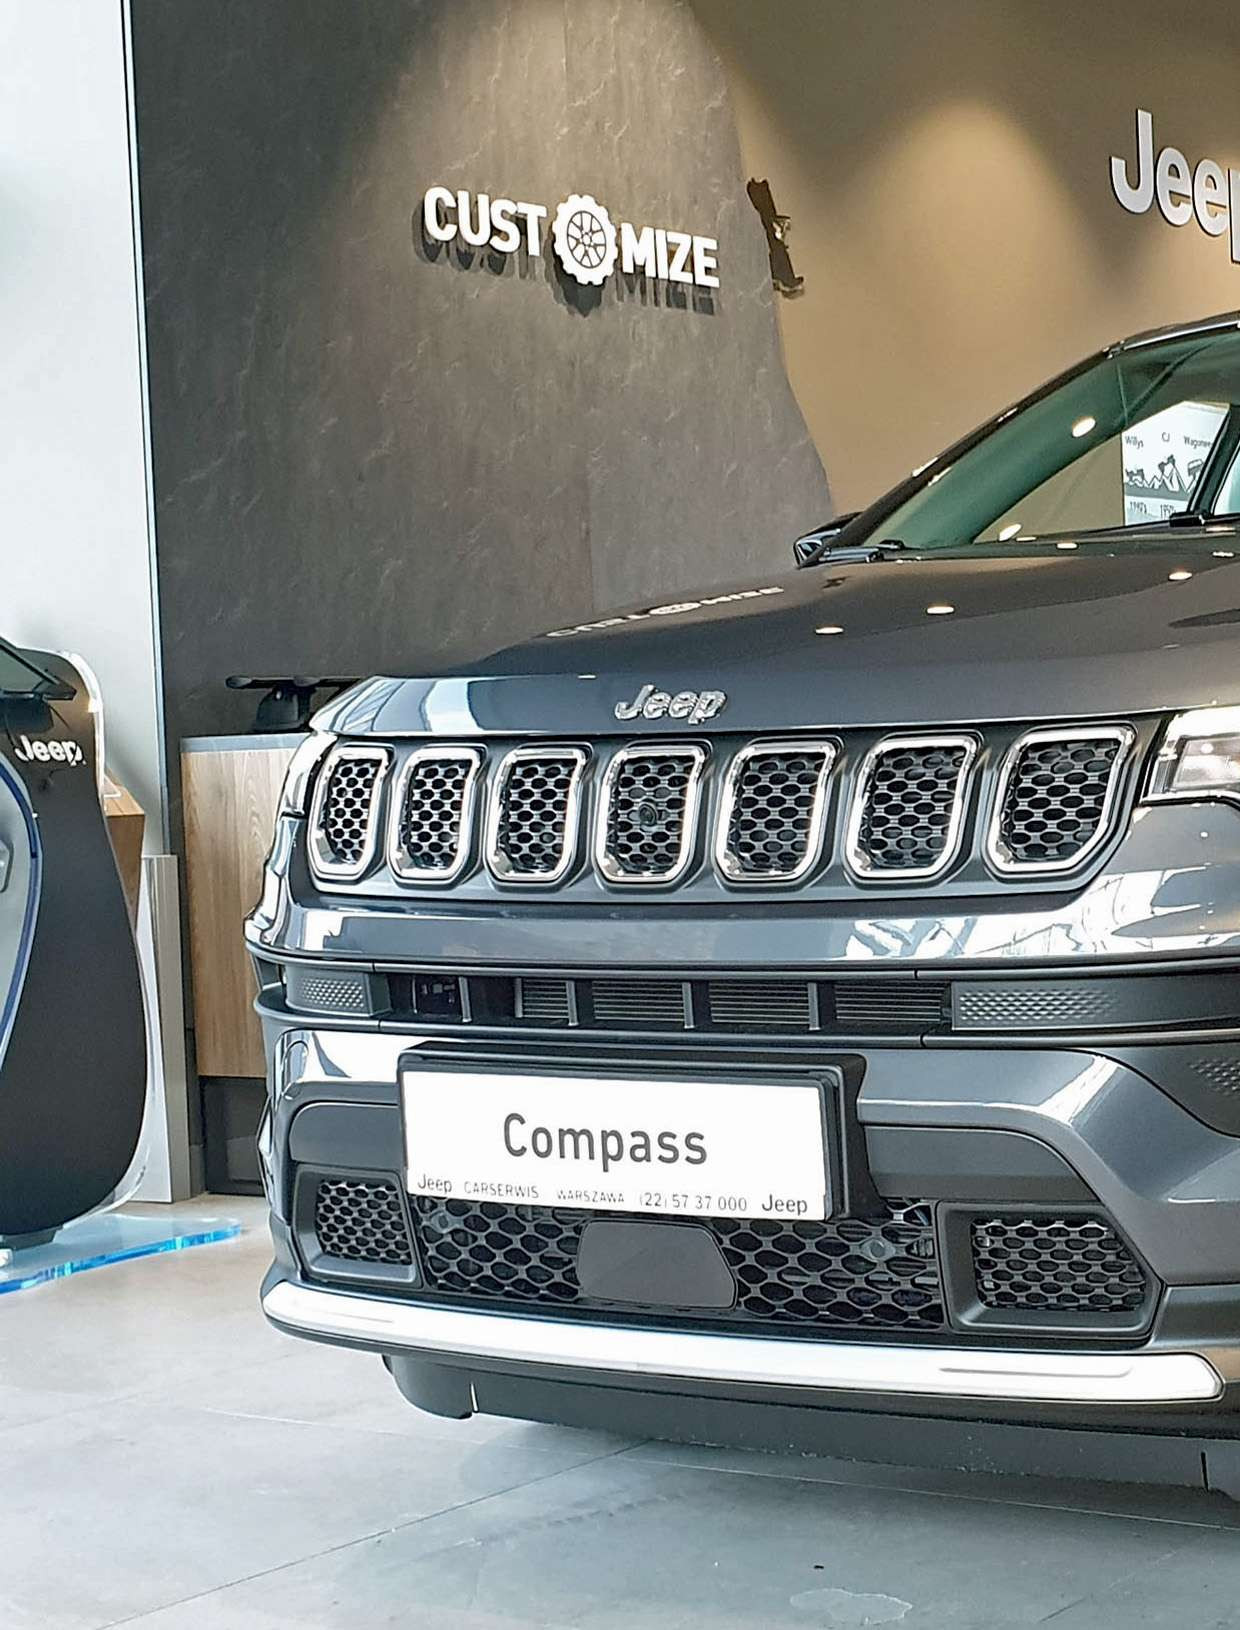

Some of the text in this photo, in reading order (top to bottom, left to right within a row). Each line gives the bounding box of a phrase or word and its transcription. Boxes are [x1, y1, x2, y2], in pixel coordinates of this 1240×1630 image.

[614, 684, 727, 725] Jeep
[14, 734, 83, 766] Jeep
[503, 1112, 708, 1173] Compass
[417, 1173, 453, 1194] Jeep
[463, 1181, 540, 1199] CARSERWIS
[557, 1189, 625, 1203] WARSZAWA
[672, 1193, 689, 1209] 57
[695, 1195, 712, 1209] 37
[718, 1196, 748, 1212] 000
[761, 1194, 808, 1216] Jeep
